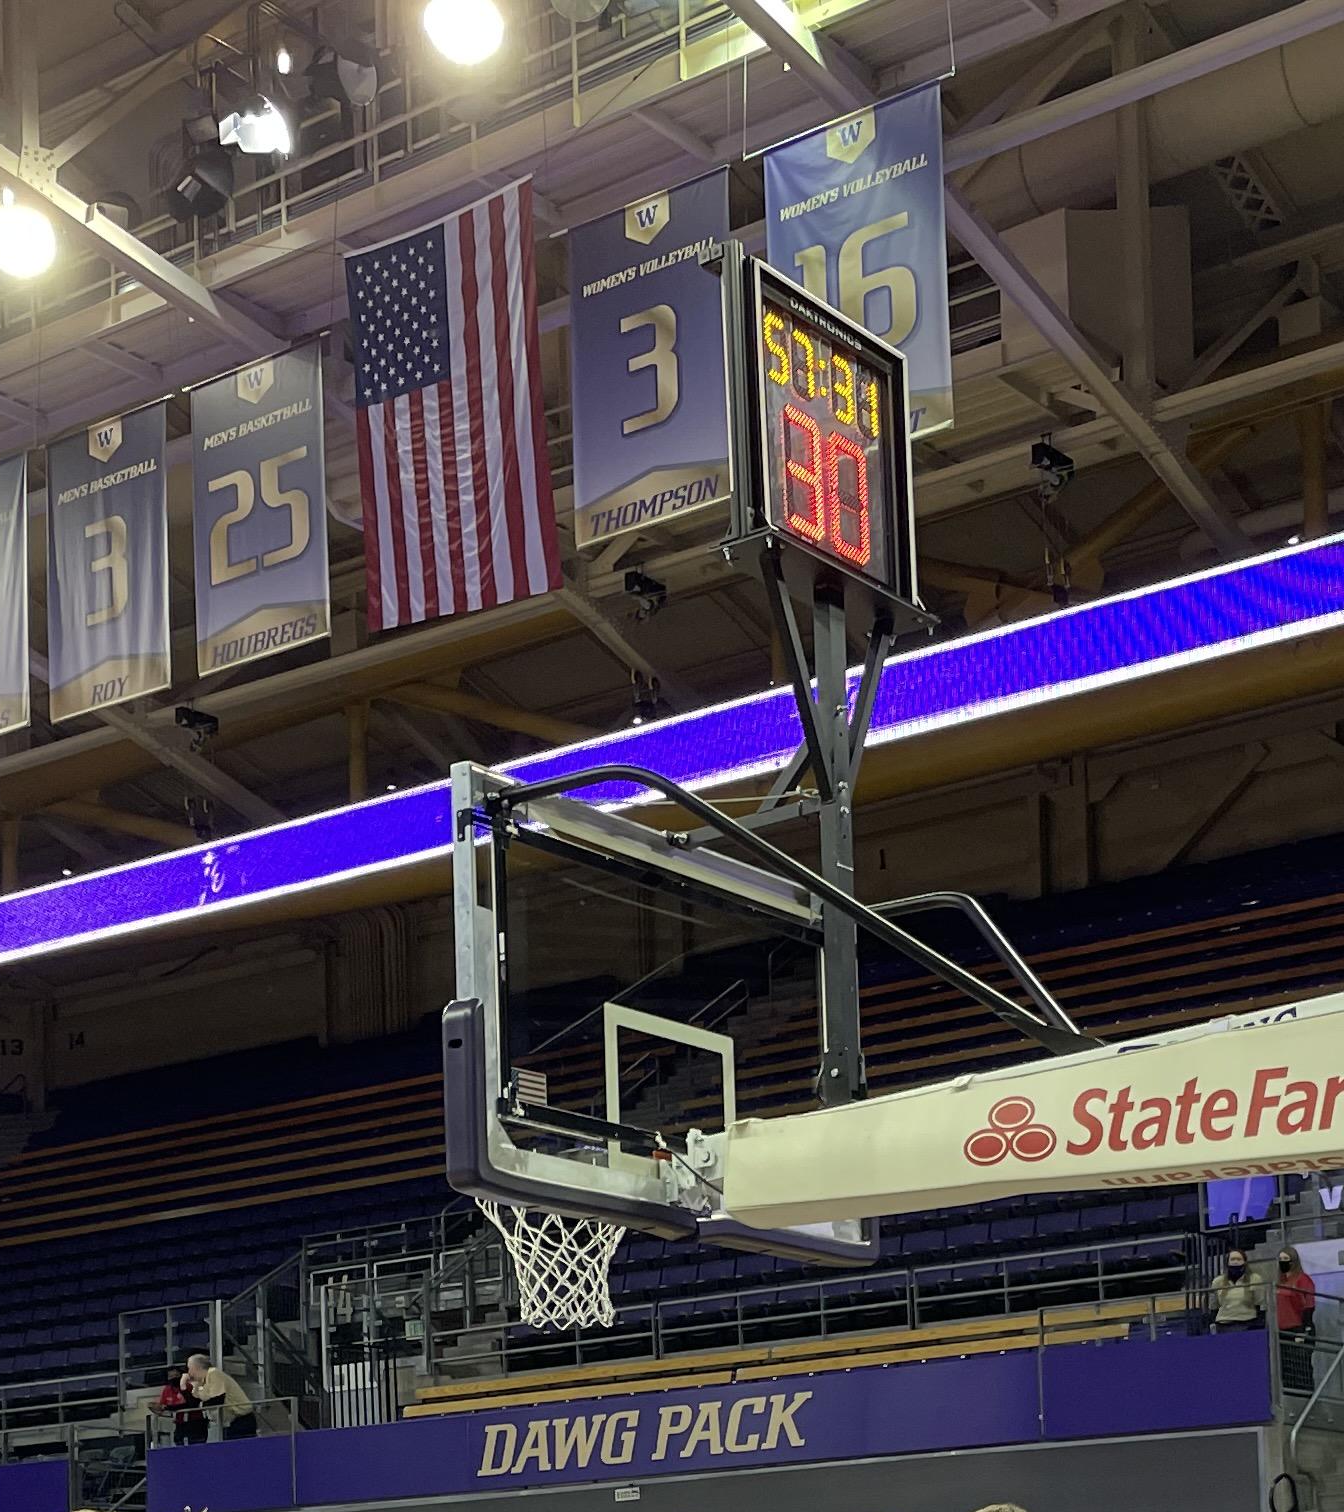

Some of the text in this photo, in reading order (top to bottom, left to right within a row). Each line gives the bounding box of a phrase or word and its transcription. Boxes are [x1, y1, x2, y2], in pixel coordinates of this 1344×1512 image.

[840, 119, 864, 147] W
[779, 153, 928, 222] WOMEN'S VOLLEYBALL
[635, 203, 658, 230] W
[581, 264, 638, 298] WOMEN'S
[794, 210, 919, 348] 16
[790, 298, 862, 352] DAKTRONICS
[245, 369, 265, 390] W
[618, 303, 680, 437] 3
[762, 311, 879, 438] 57:31
[96, 428, 115, 448] W
[202, 398, 313, 452] MEN'S BASKETBALL
[57, 458, 157, 506] MEN'S BASKETBALL
[589, 474, 719, 533] THOMPSON
[783, 403, 870, 565] 30
[207, 445, 310, 586] 25
[85, 515, 129, 627] 3
[212, 614, 317, 668] HOUBREGS
[91, 676, 129, 706] ROY
[477, 1391, 813, 1477] DAWG PACK
